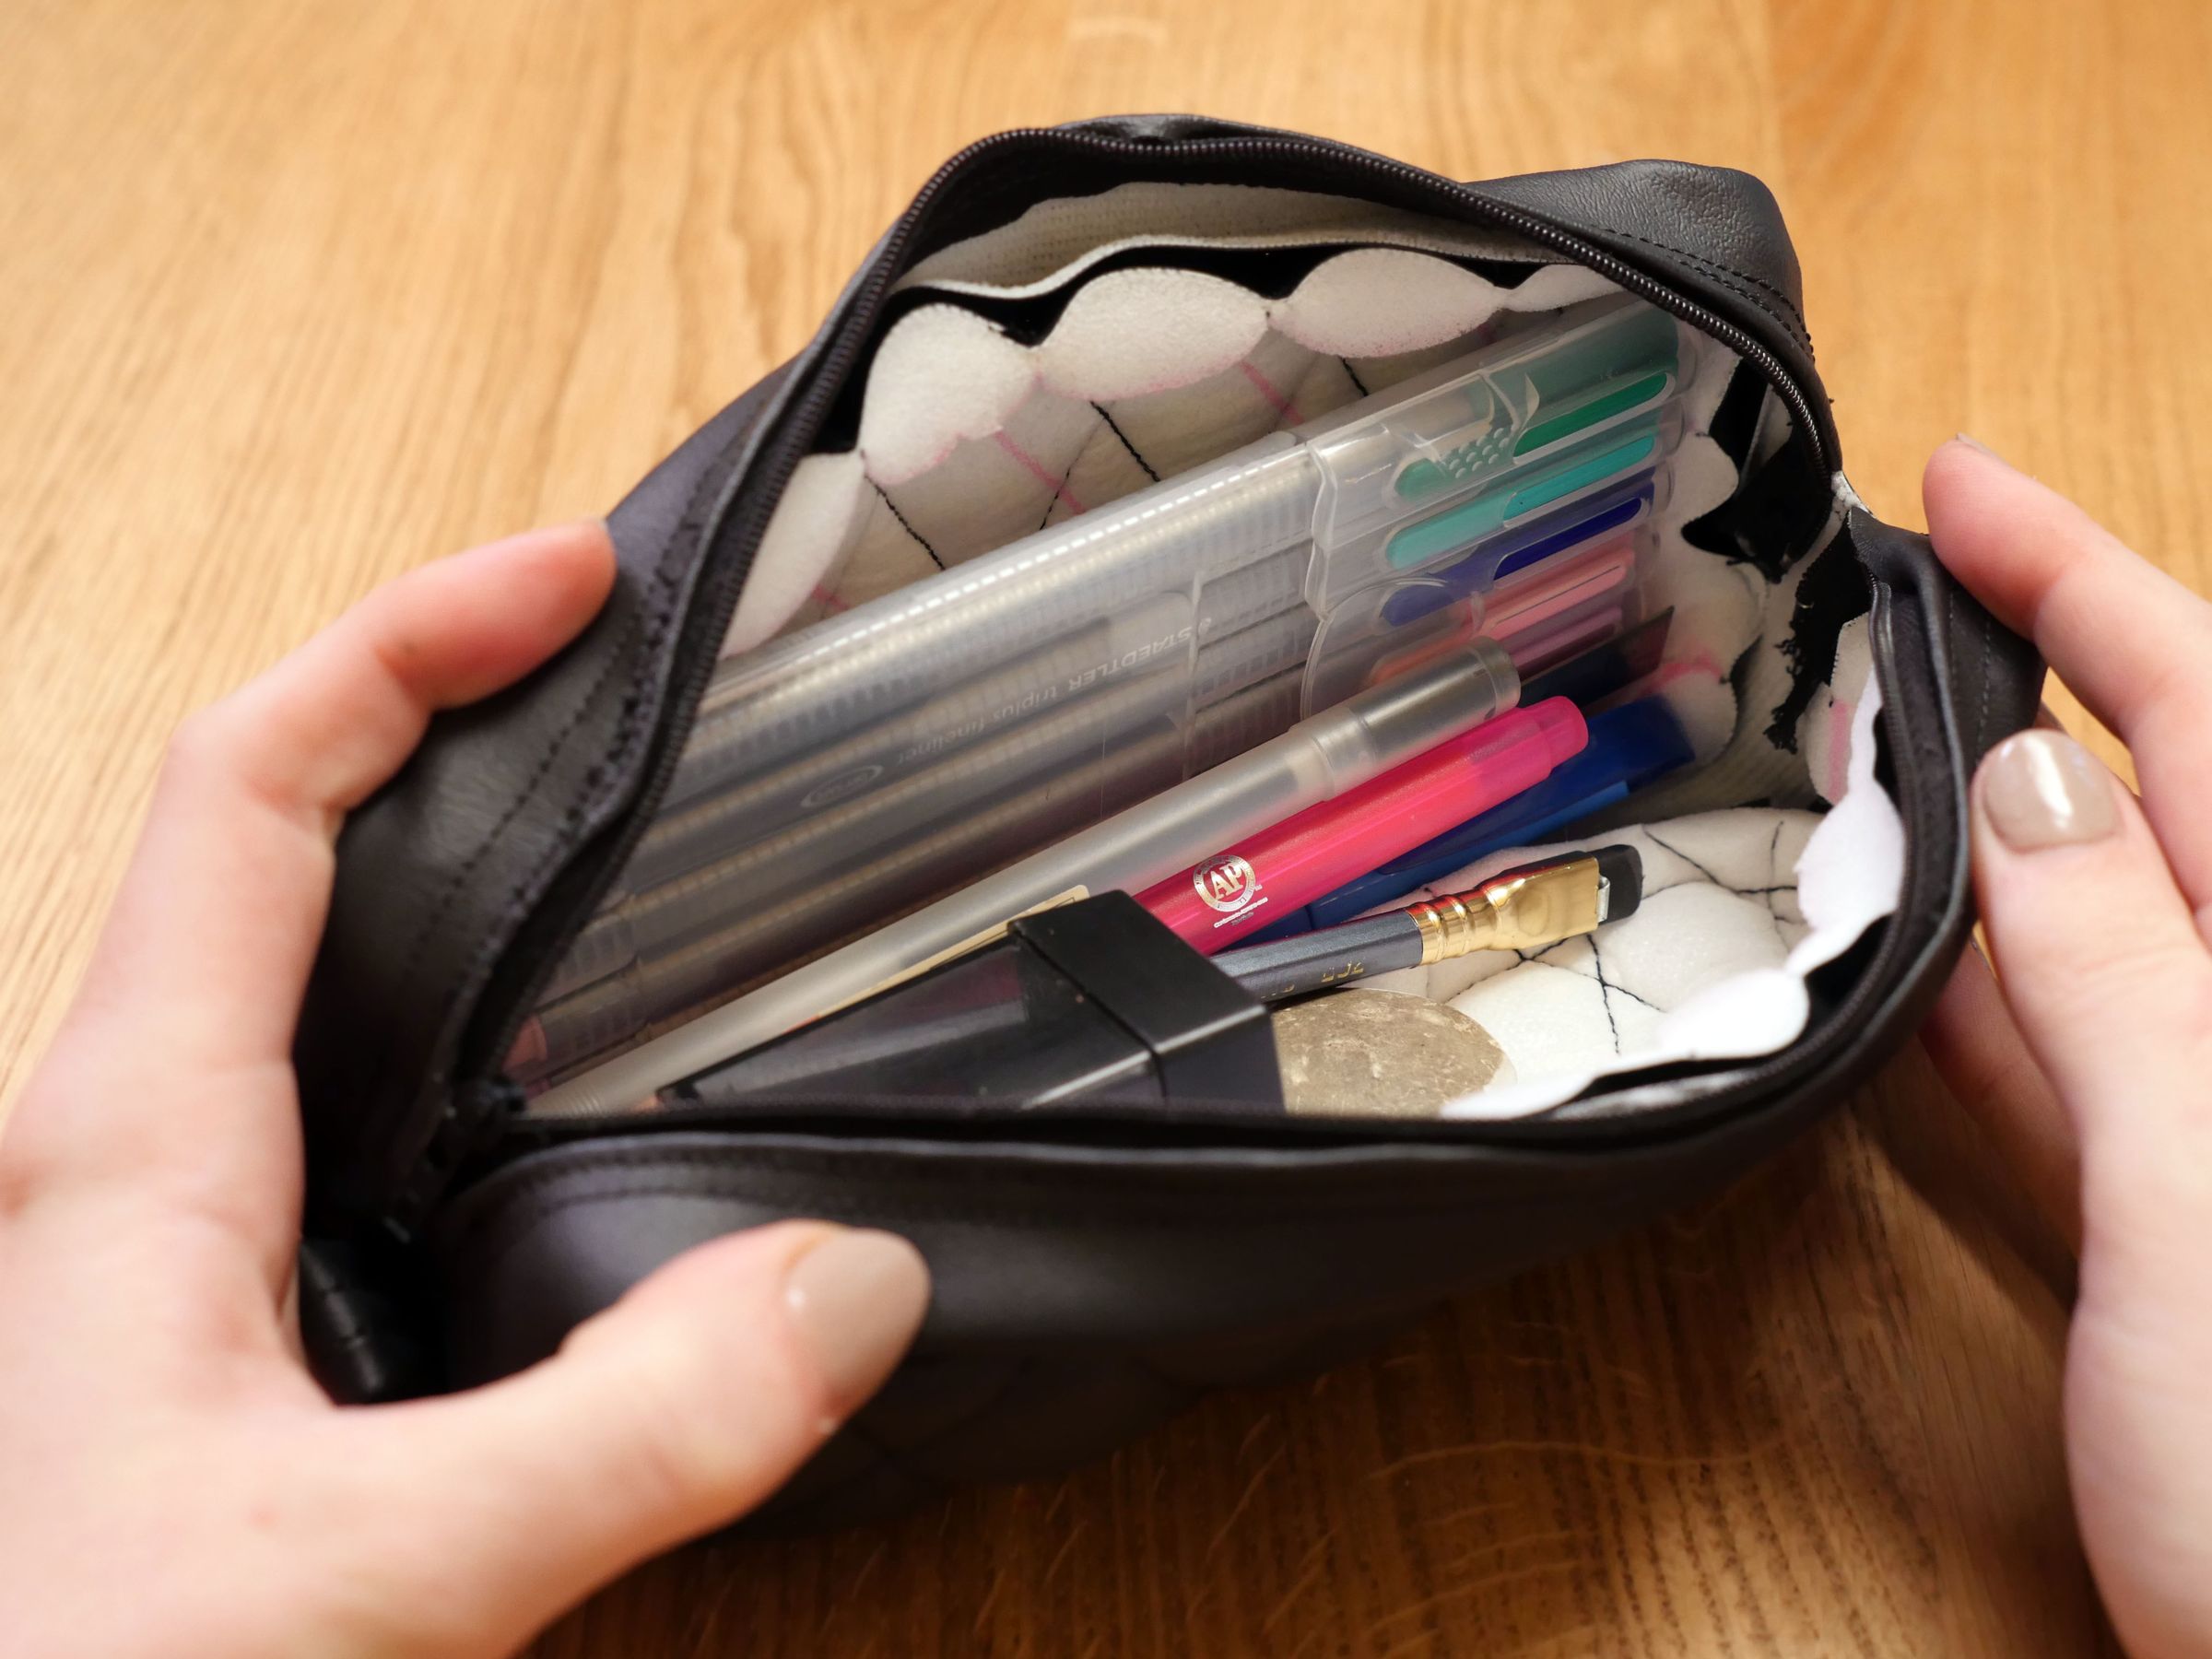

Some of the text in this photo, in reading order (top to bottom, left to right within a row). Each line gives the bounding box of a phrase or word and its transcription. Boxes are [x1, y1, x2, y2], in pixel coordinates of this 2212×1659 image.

[898, 626, 1193, 765] STAEDTLER triplus fineliner
[1209, 862, 1244, 900] AP
